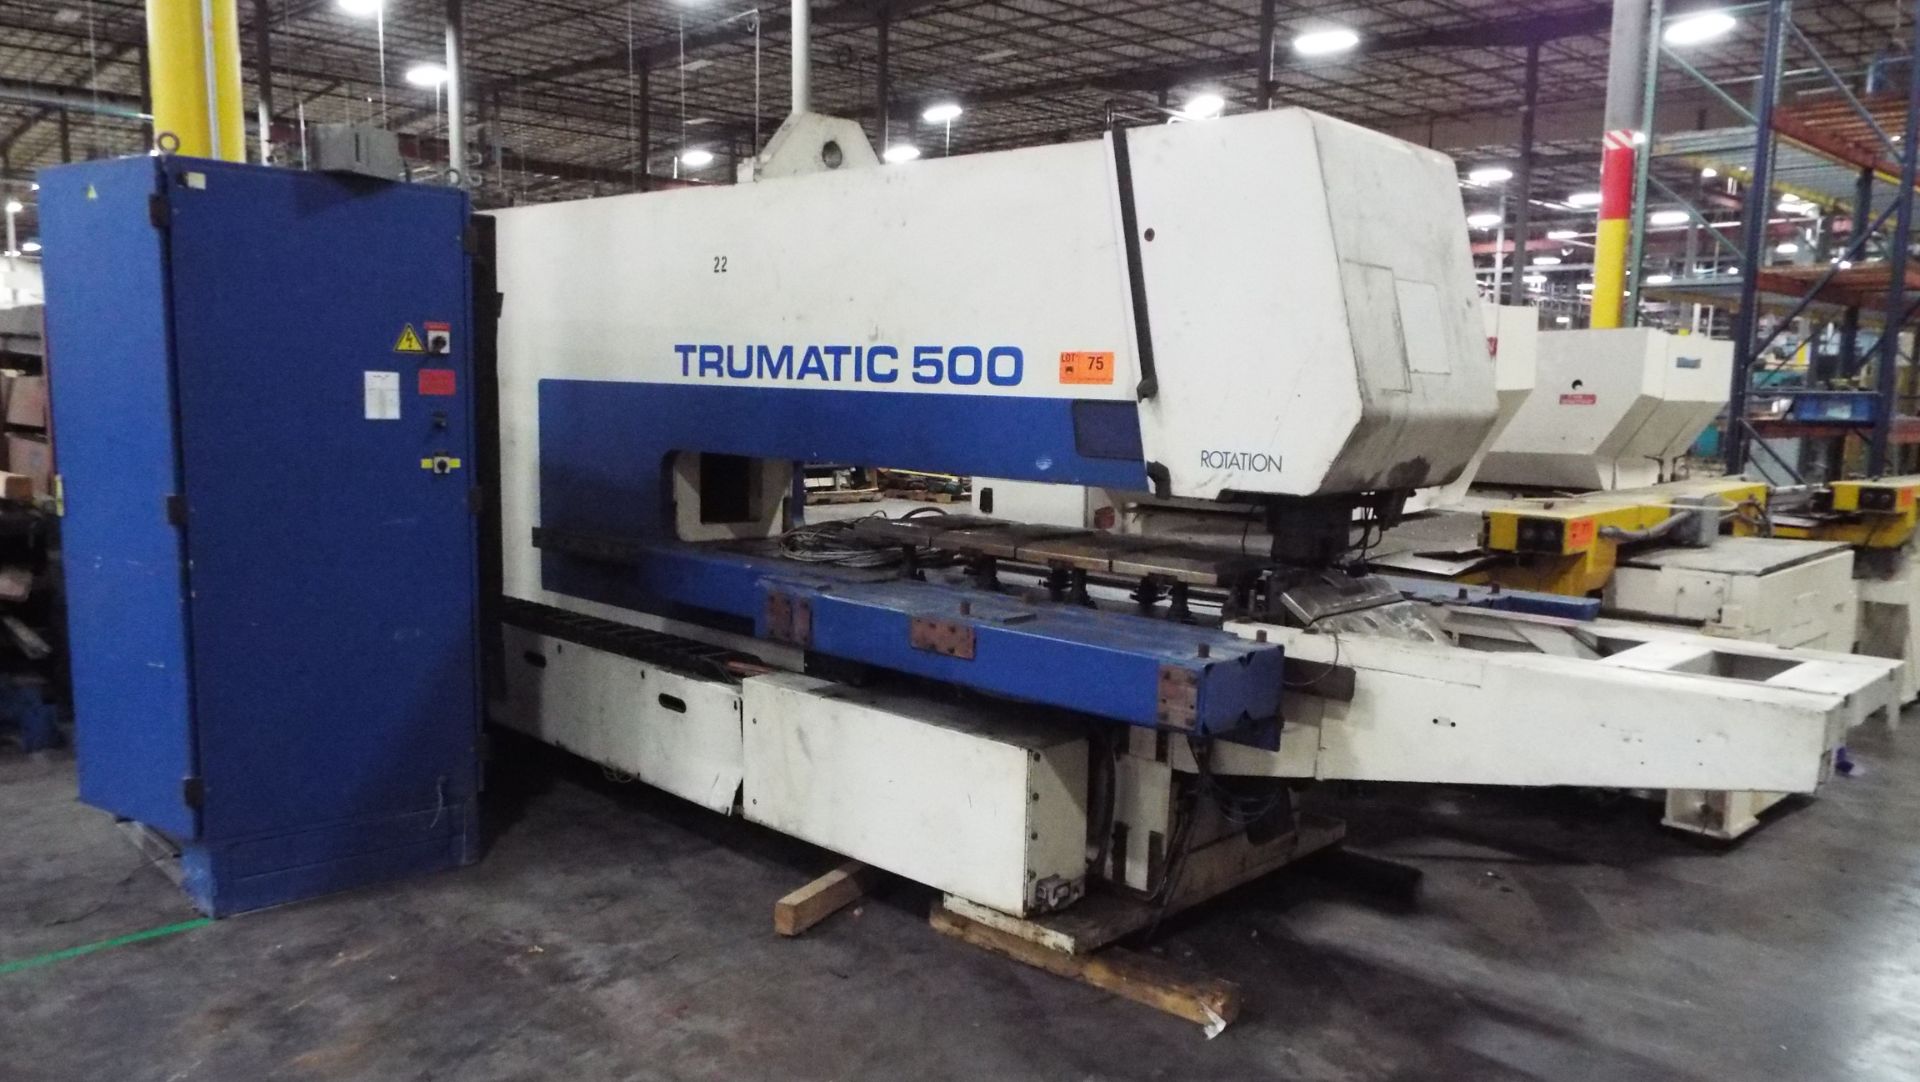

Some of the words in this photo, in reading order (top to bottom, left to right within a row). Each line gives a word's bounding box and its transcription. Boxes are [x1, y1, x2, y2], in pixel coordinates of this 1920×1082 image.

[713, 255, 728, 273] 22
[674, 344, 899, 384] TRUMATIC
[911, 345, 1024, 387] 500
[1087, 356, 1104, 371] 75
[1200, 449, 1283, 473] ROTATION
